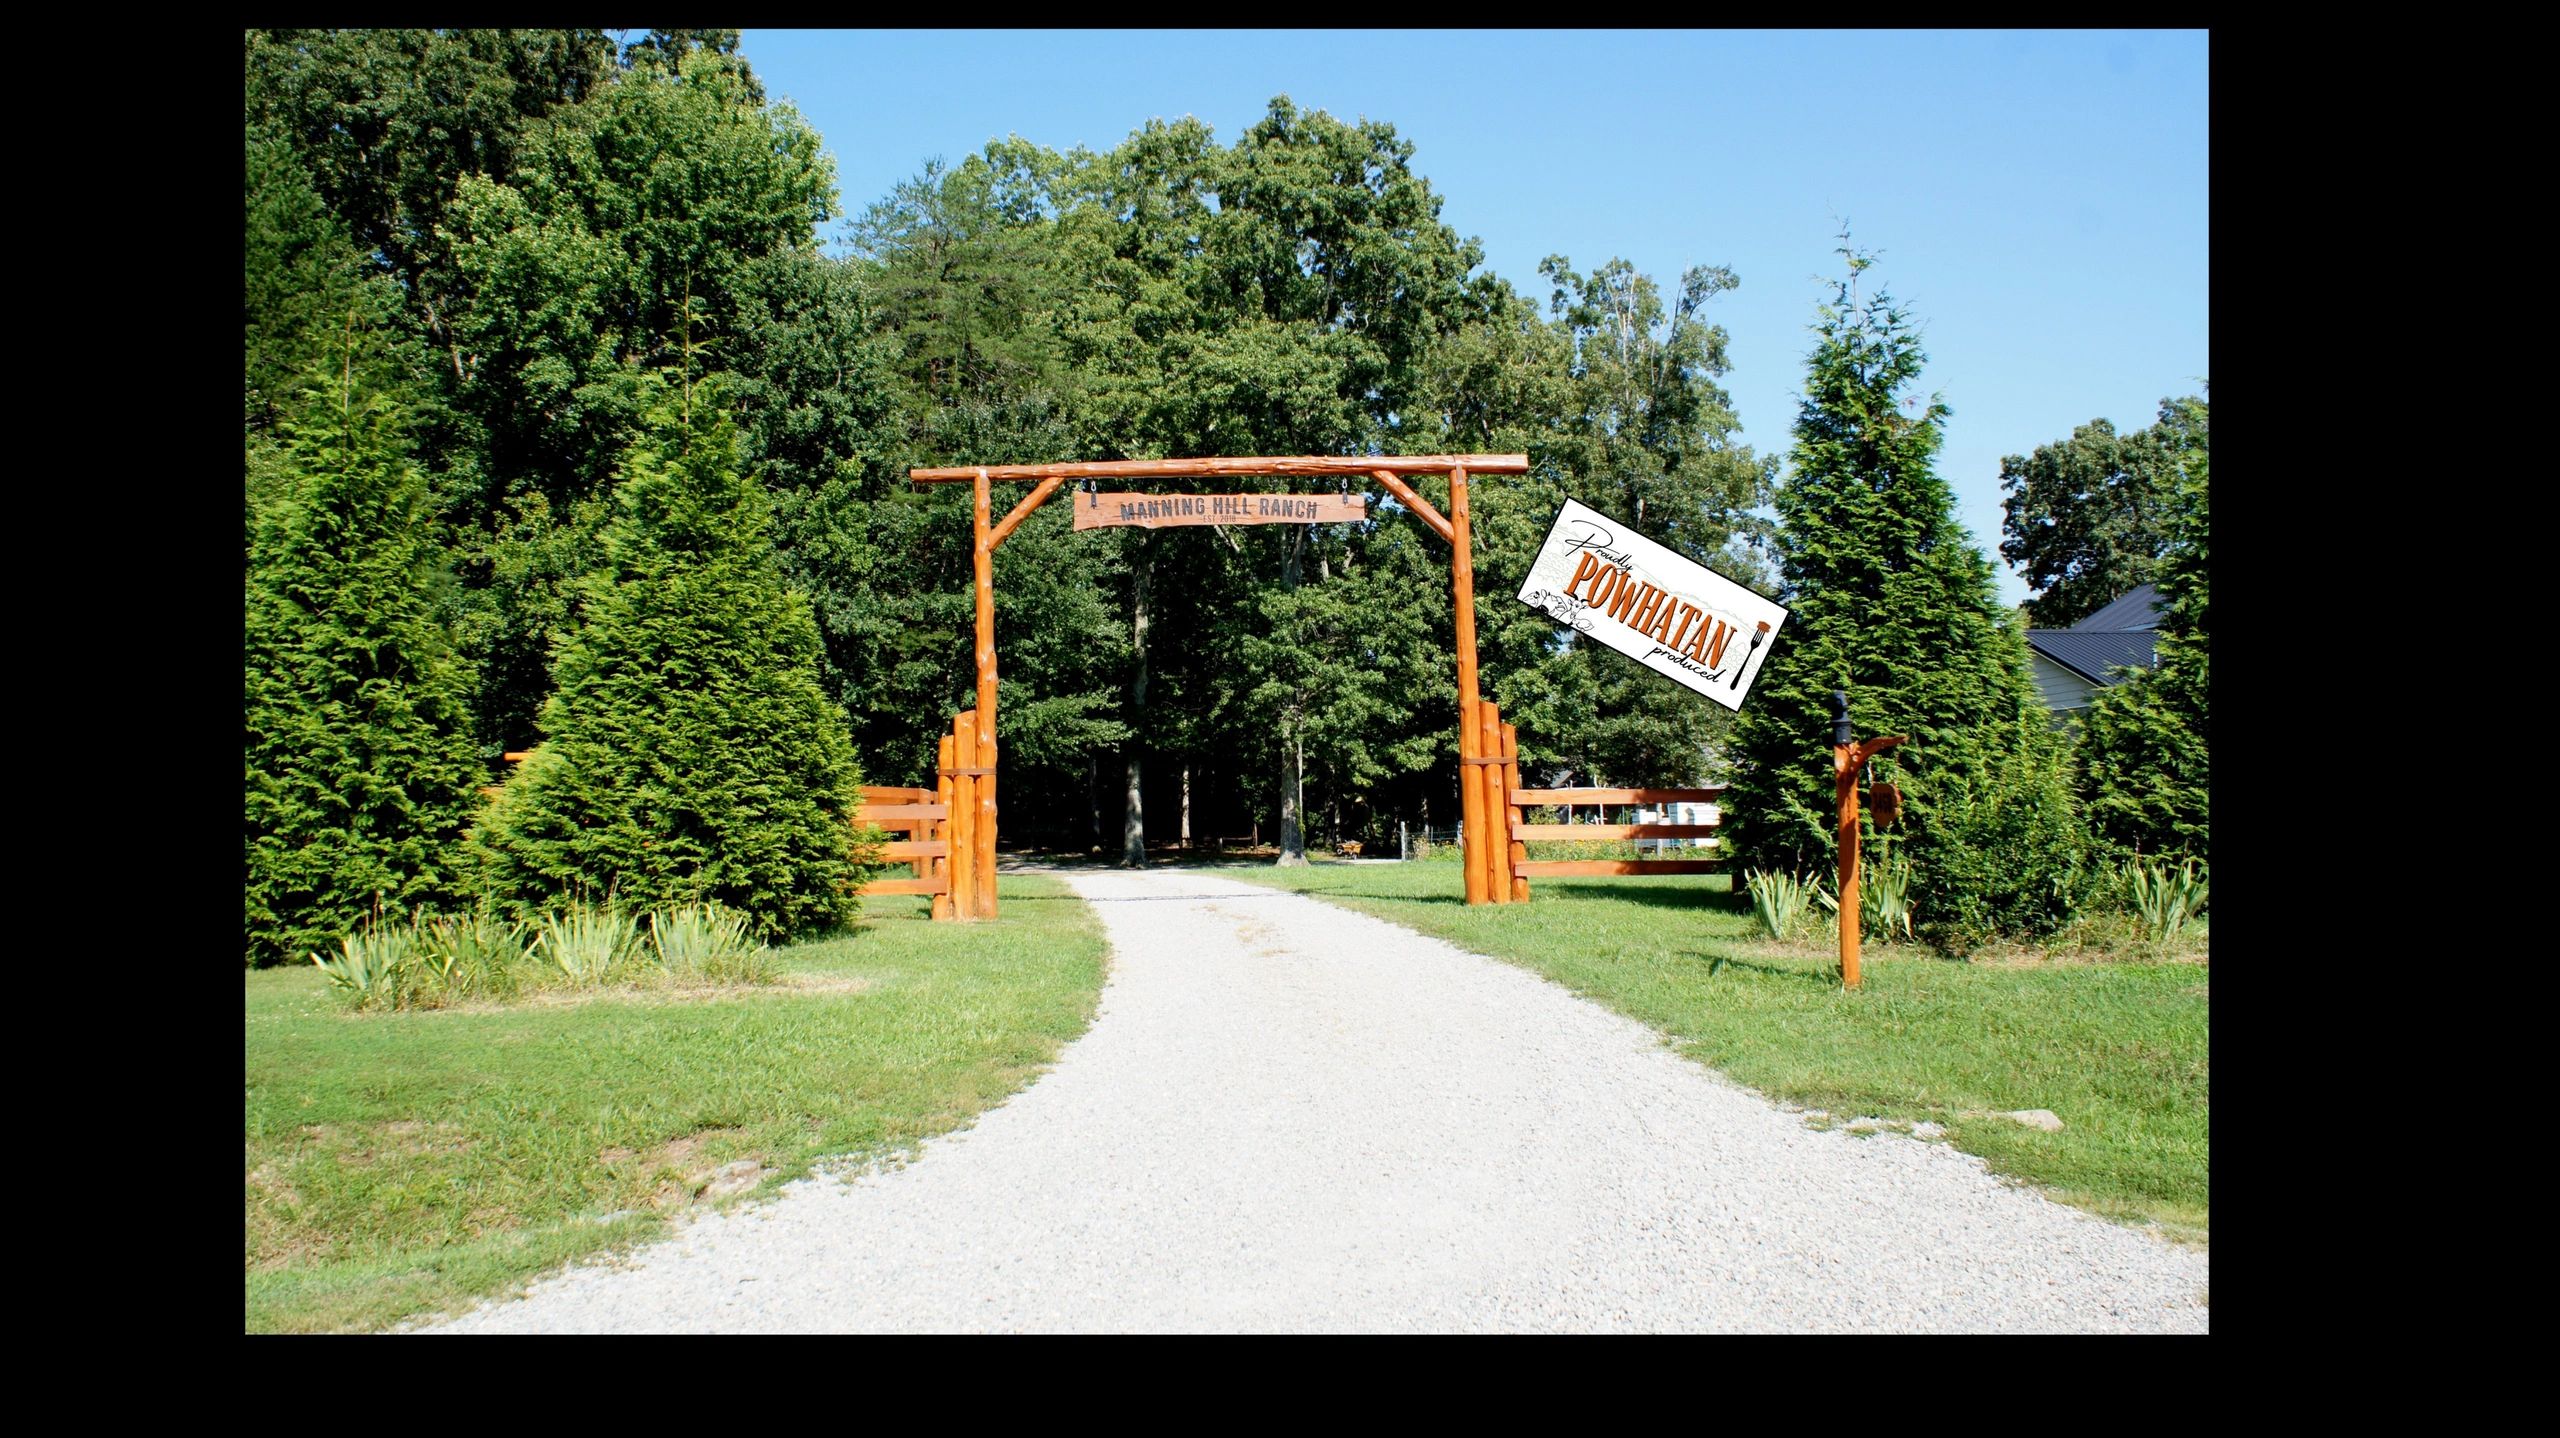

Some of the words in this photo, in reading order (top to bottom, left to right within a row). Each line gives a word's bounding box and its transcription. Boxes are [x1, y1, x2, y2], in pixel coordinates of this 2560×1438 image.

[1120, 498, 1204, 521] MANNING
[1213, 497, 1251, 515] HILL
[1259, 498, 1317, 519] RANCH
